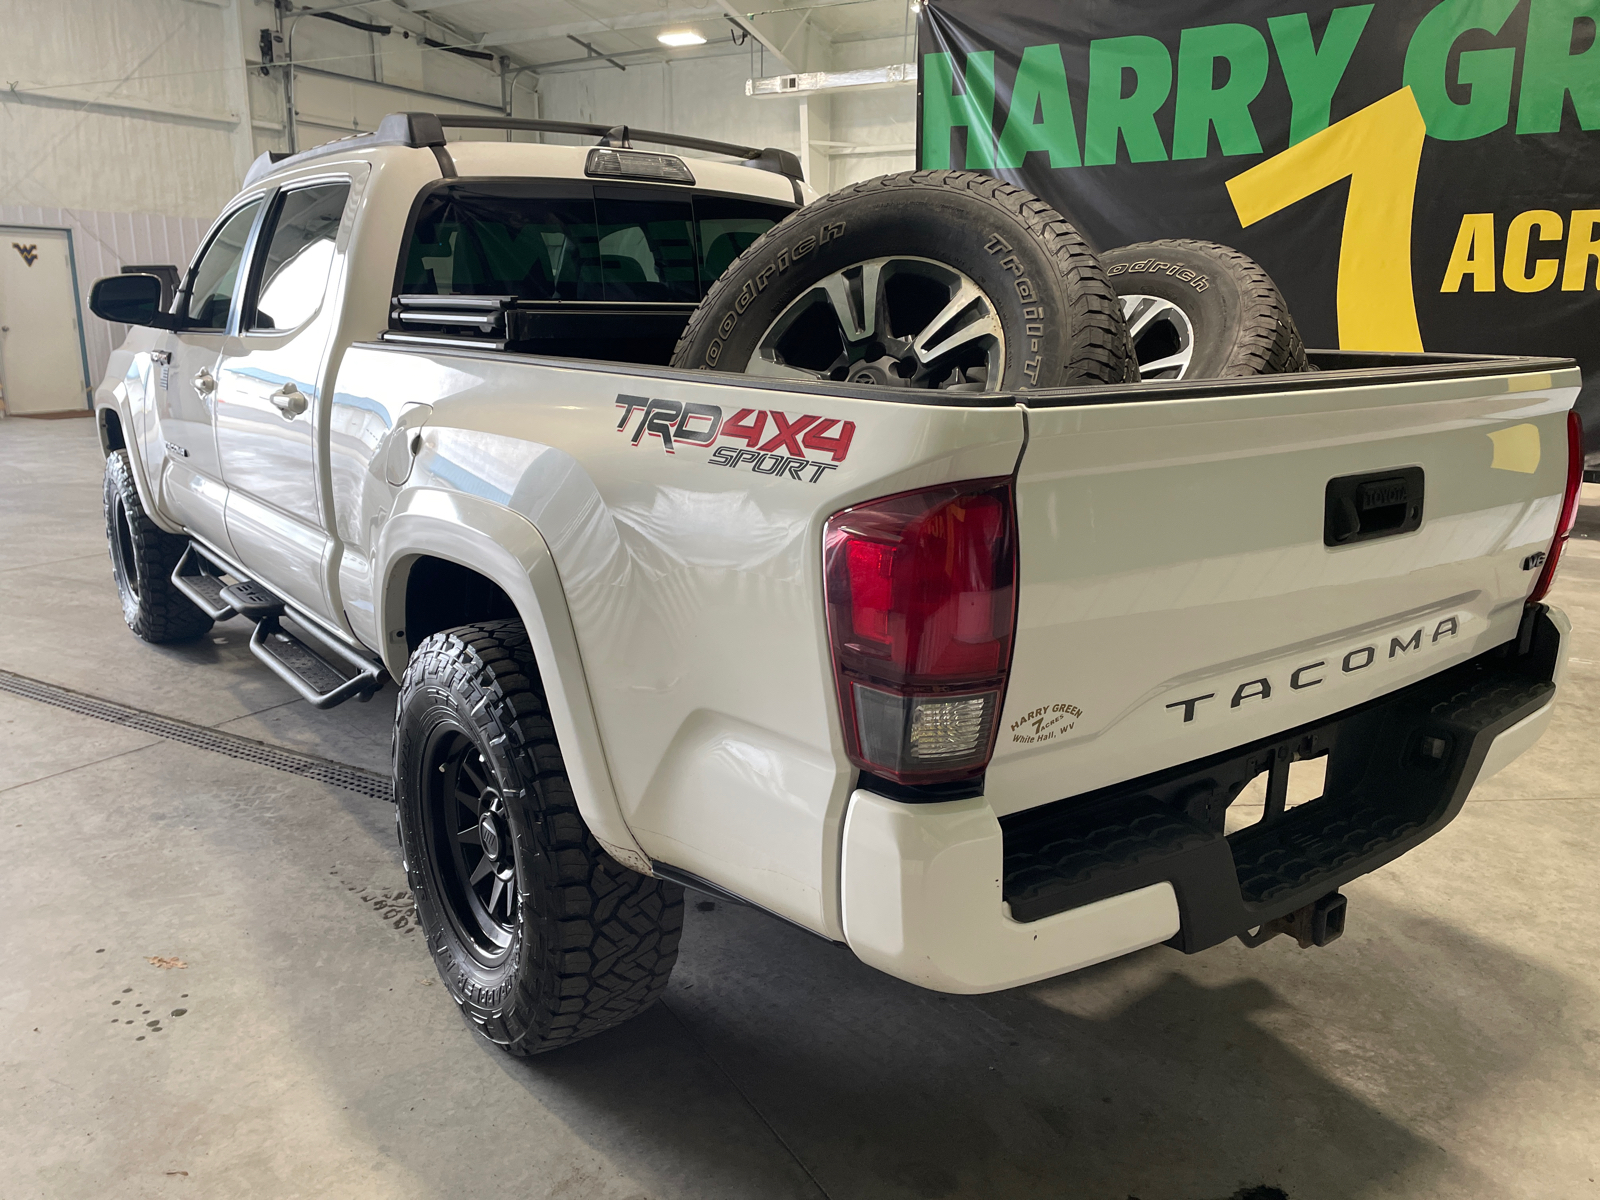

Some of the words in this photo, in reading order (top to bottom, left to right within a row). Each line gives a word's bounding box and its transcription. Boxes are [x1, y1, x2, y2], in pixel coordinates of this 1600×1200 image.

[922, 3, 1375, 170] HARRY
[1225, 85, 1426, 352] 7
[700, 221, 846, 371] oodrich
[984, 232, 1044, 390] Trail-T
[615, 394, 723, 455] TRD
[720, 407, 856, 462] 4X4
[708, 446, 838, 484] SPORT
[1165, 614, 1459, 723] TACOMA
[1010, 705, 1050, 731] HARRY
[1051, 703, 1083, 719] GREEN
[1012, 733, 1035, 744] White
[1036, 731, 1057, 743] Hall,
[1060, 721, 1075, 735] WV
[1031, 717, 1044, 735] 7
[1041, 714, 1064, 731] ACRES
